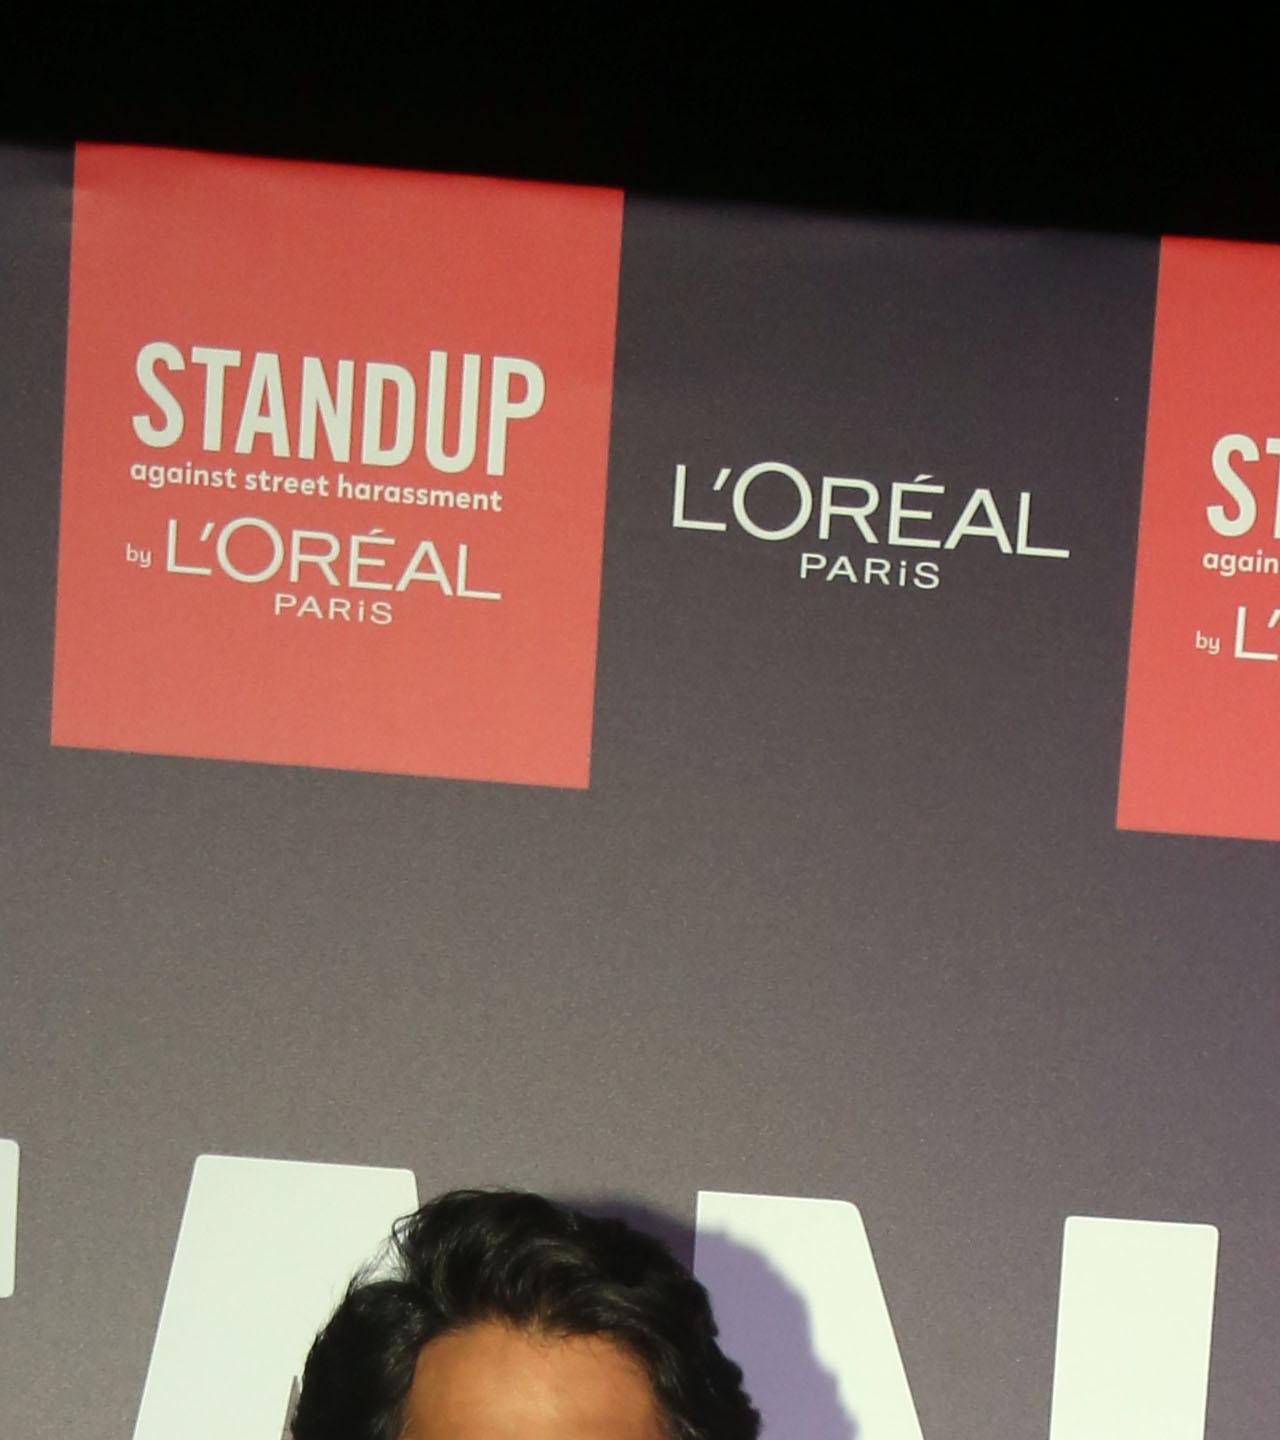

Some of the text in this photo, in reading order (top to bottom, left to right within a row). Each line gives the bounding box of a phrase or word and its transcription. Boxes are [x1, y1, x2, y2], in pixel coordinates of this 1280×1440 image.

[129, 340, 547, 477] STANDUP
[129, 460, 504, 514] against street harassment
[671, 460, 1071, 560] L'ORÉAL
[124, 515, 503, 601] by L'ORÉAL
[1194, 628, 1222, 656] by
